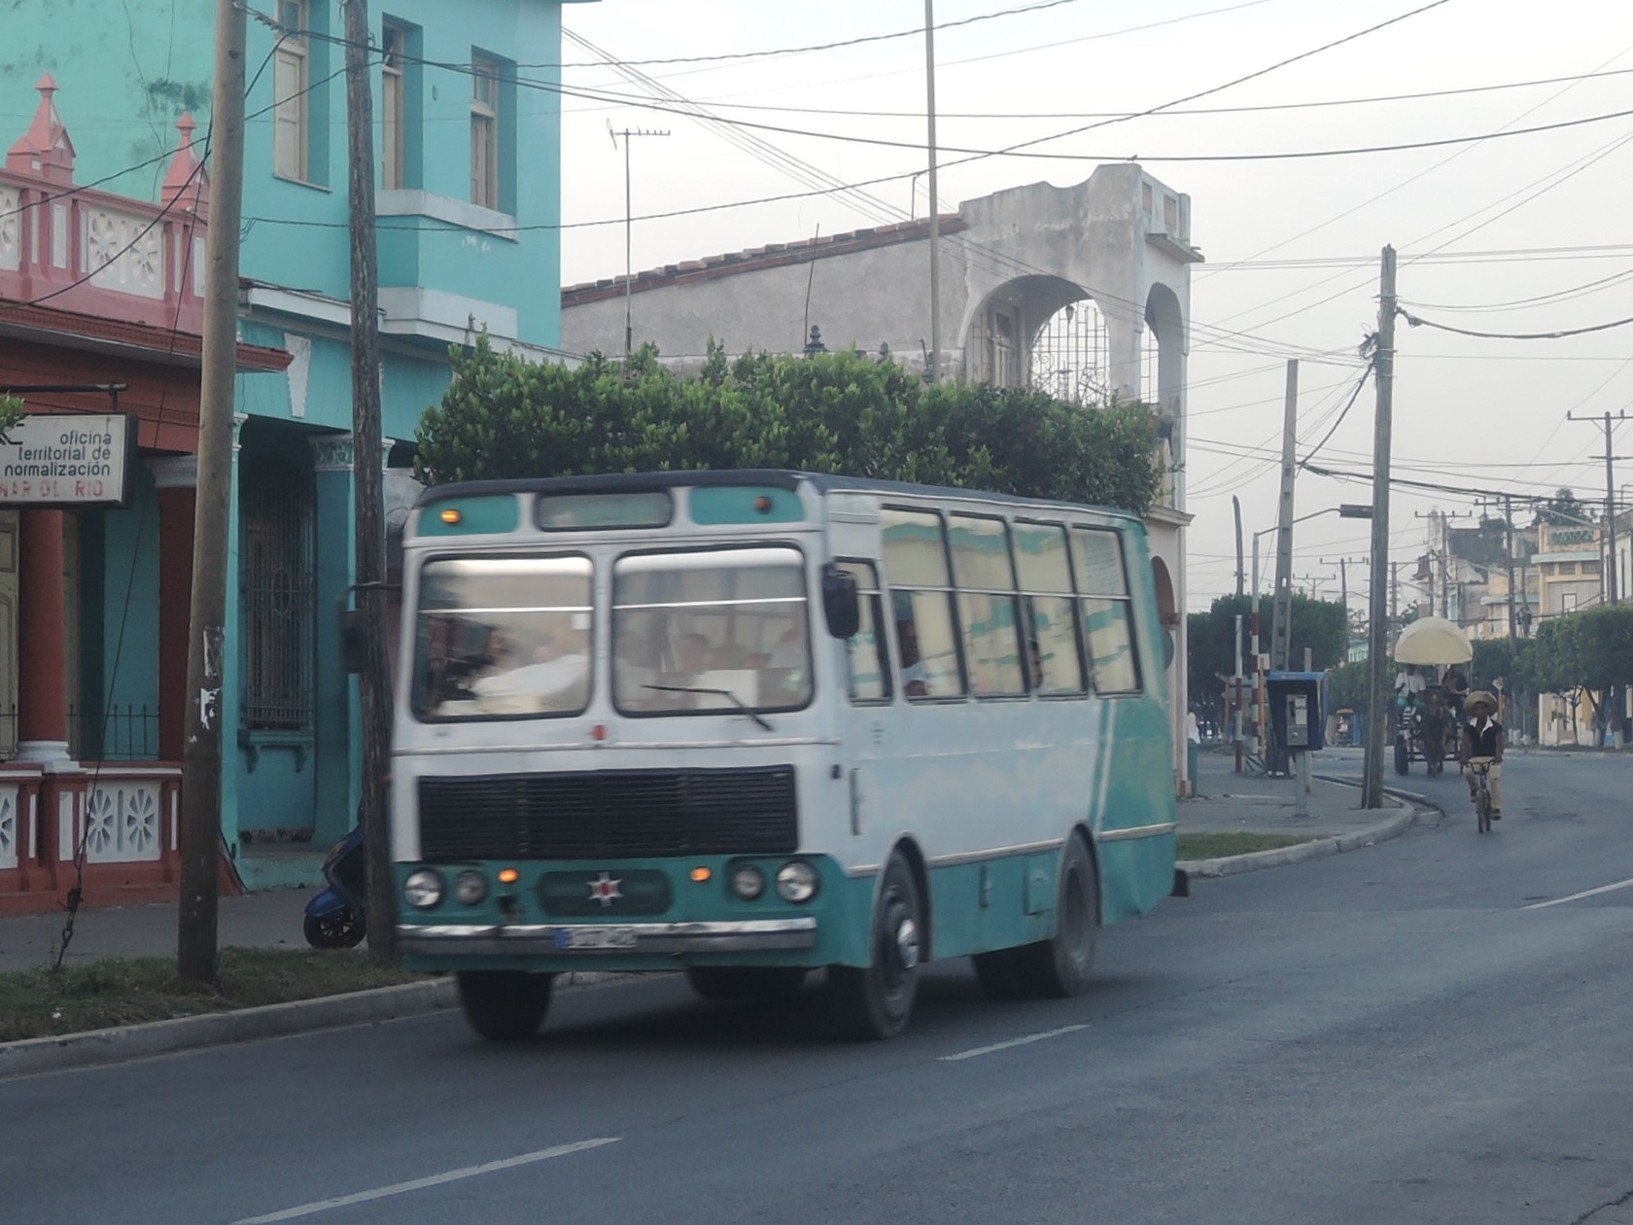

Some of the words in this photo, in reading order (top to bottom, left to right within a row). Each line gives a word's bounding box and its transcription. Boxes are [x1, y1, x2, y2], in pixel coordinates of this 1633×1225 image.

[60, 430, 112, 445] oficina
[19, 446, 86, 461] territorial
[92, 446, 111, 460] de
[4, 462, 111, 477] normalización
